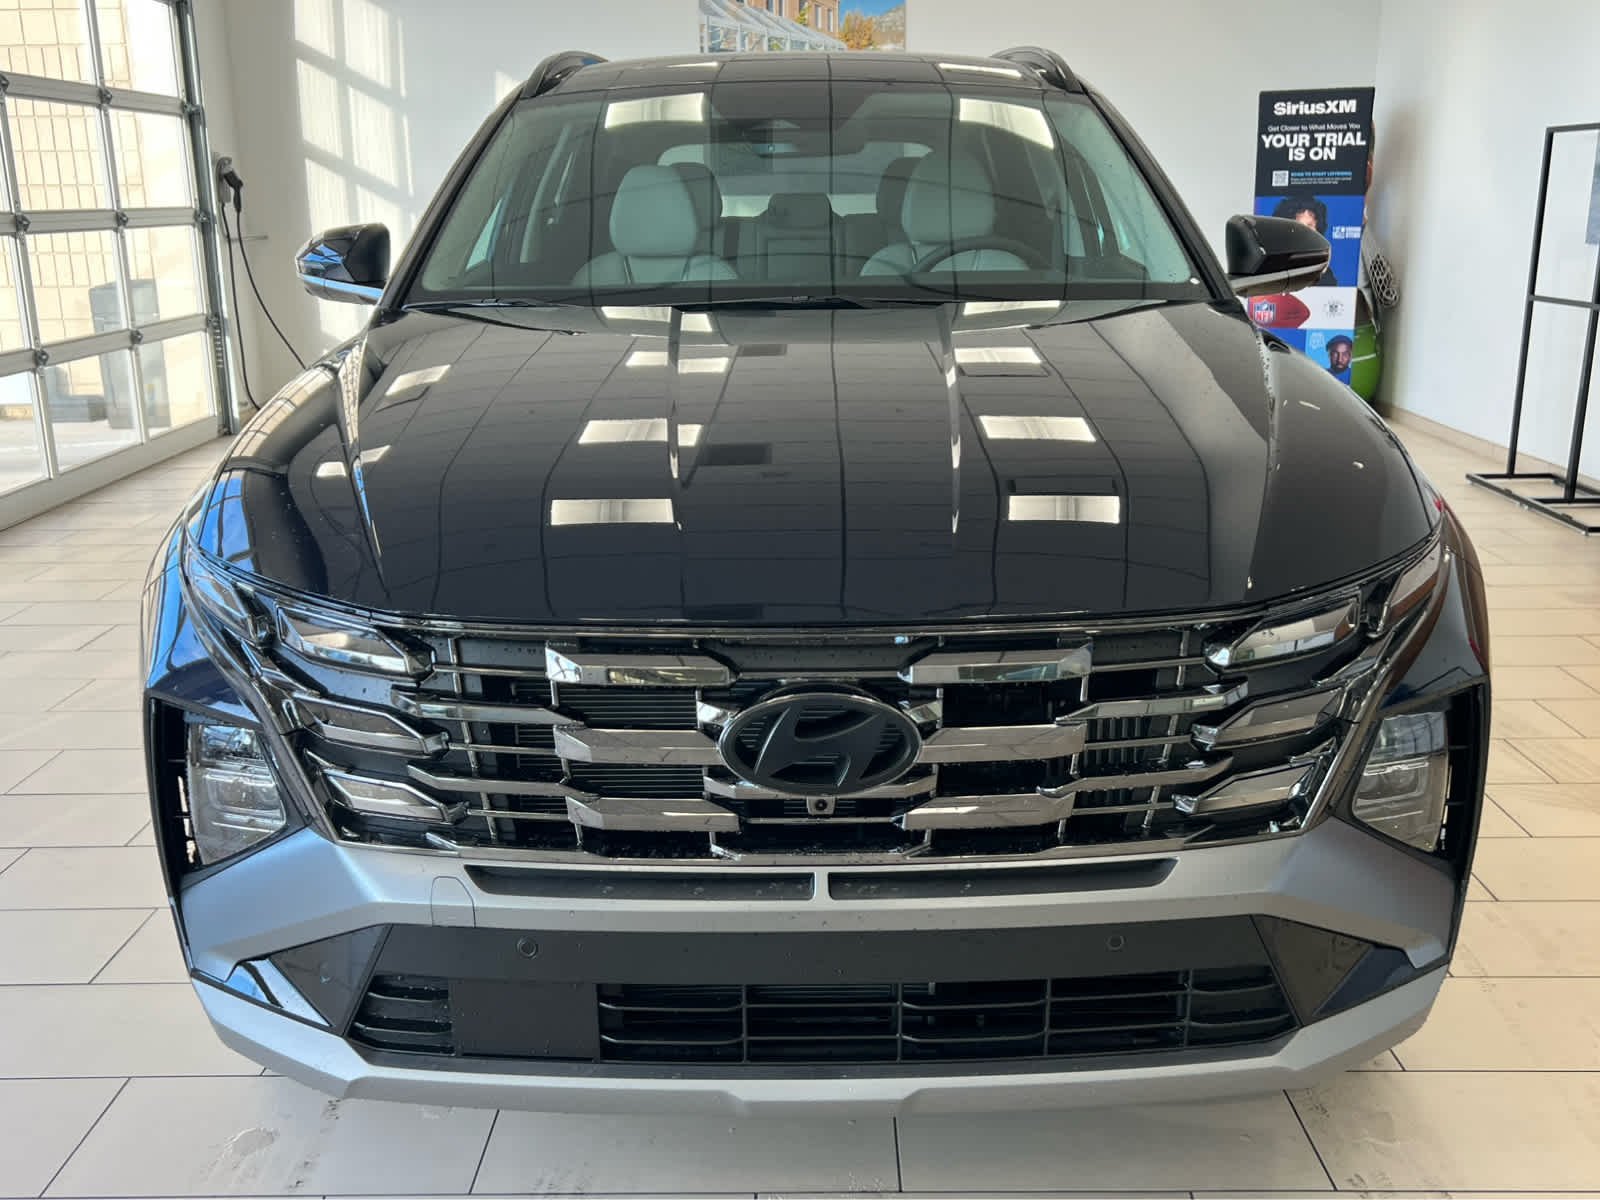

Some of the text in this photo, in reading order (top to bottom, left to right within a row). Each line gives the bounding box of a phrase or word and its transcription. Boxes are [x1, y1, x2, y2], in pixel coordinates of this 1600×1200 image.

[1273, 99, 1357, 115] SiriusXM
[1261, 132, 1366, 148] YOUR TRIAL
[1288, 147, 1336, 161] IS ON
